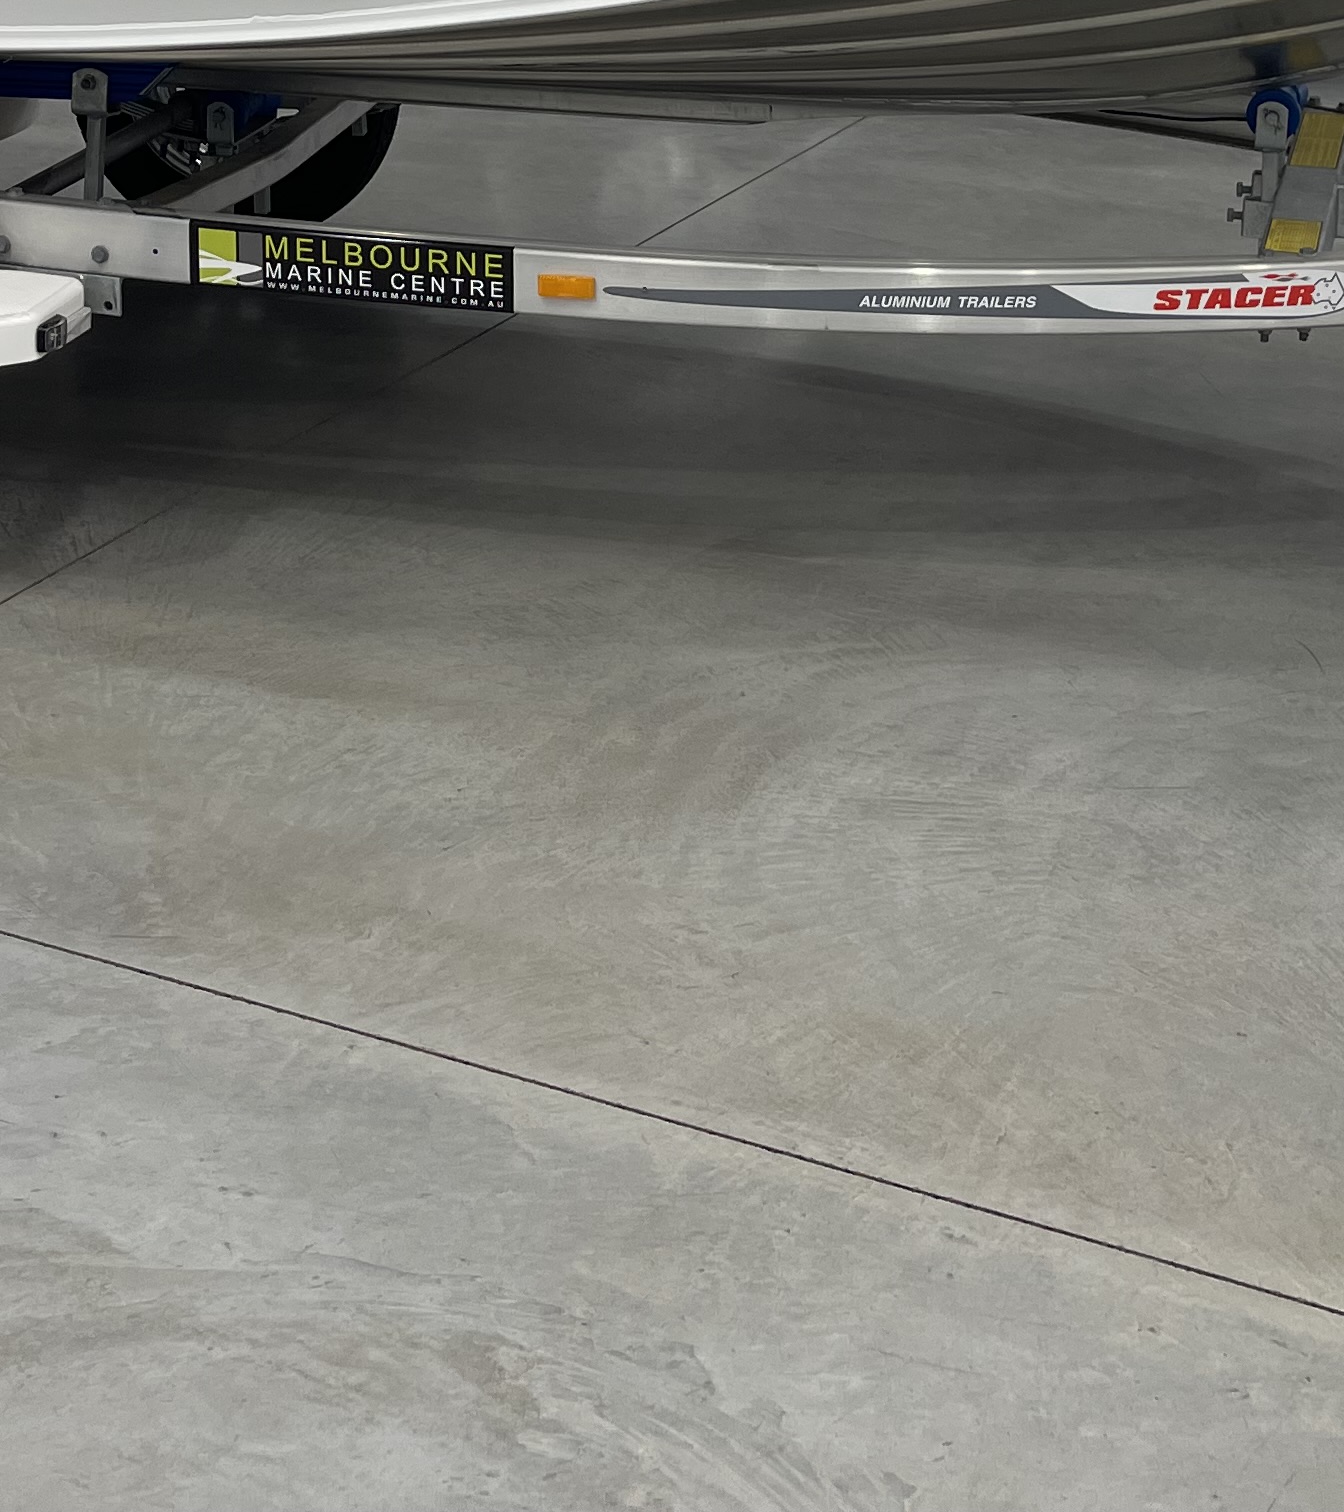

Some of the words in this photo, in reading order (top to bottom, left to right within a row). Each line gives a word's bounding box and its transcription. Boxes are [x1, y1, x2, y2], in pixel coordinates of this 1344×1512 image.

[265, 235, 504, 279] MELBOURNE
[265, 262, 373, 288] MARINE
[390, 273, 504, 299] CENTRE
[266, 281, 504, 308] WWW.MELBOURNEMARINE.COM.AU
[858, 295, 952, 309] ALUMINIUM
[957, 295, 1037, 310] TRAILERS
[1153, 285, 1316, 311] STACER
